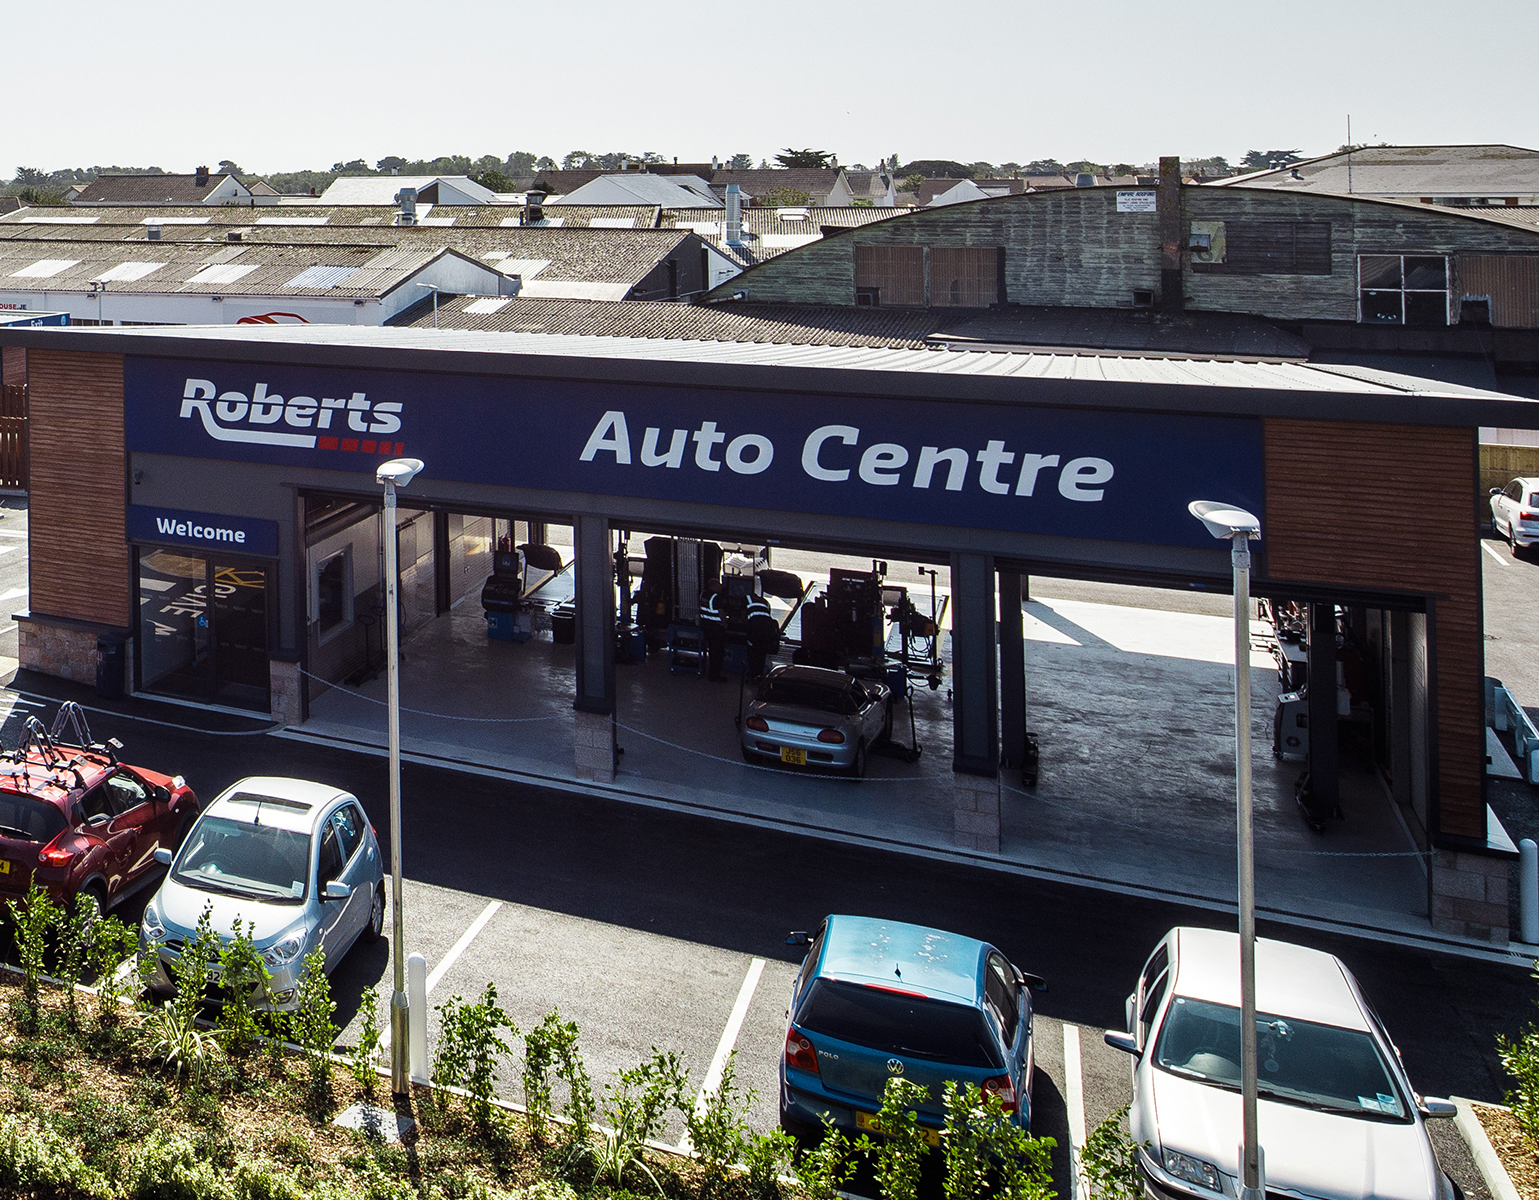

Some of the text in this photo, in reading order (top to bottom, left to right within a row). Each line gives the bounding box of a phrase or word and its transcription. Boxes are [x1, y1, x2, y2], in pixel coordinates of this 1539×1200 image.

[179, 378, 404, 449] Roberts
[579, 410, 1115, 502] Auto Centre
[156, 517, 246, 543] Welcome
[818, 1050, 839, 1060] POLO
